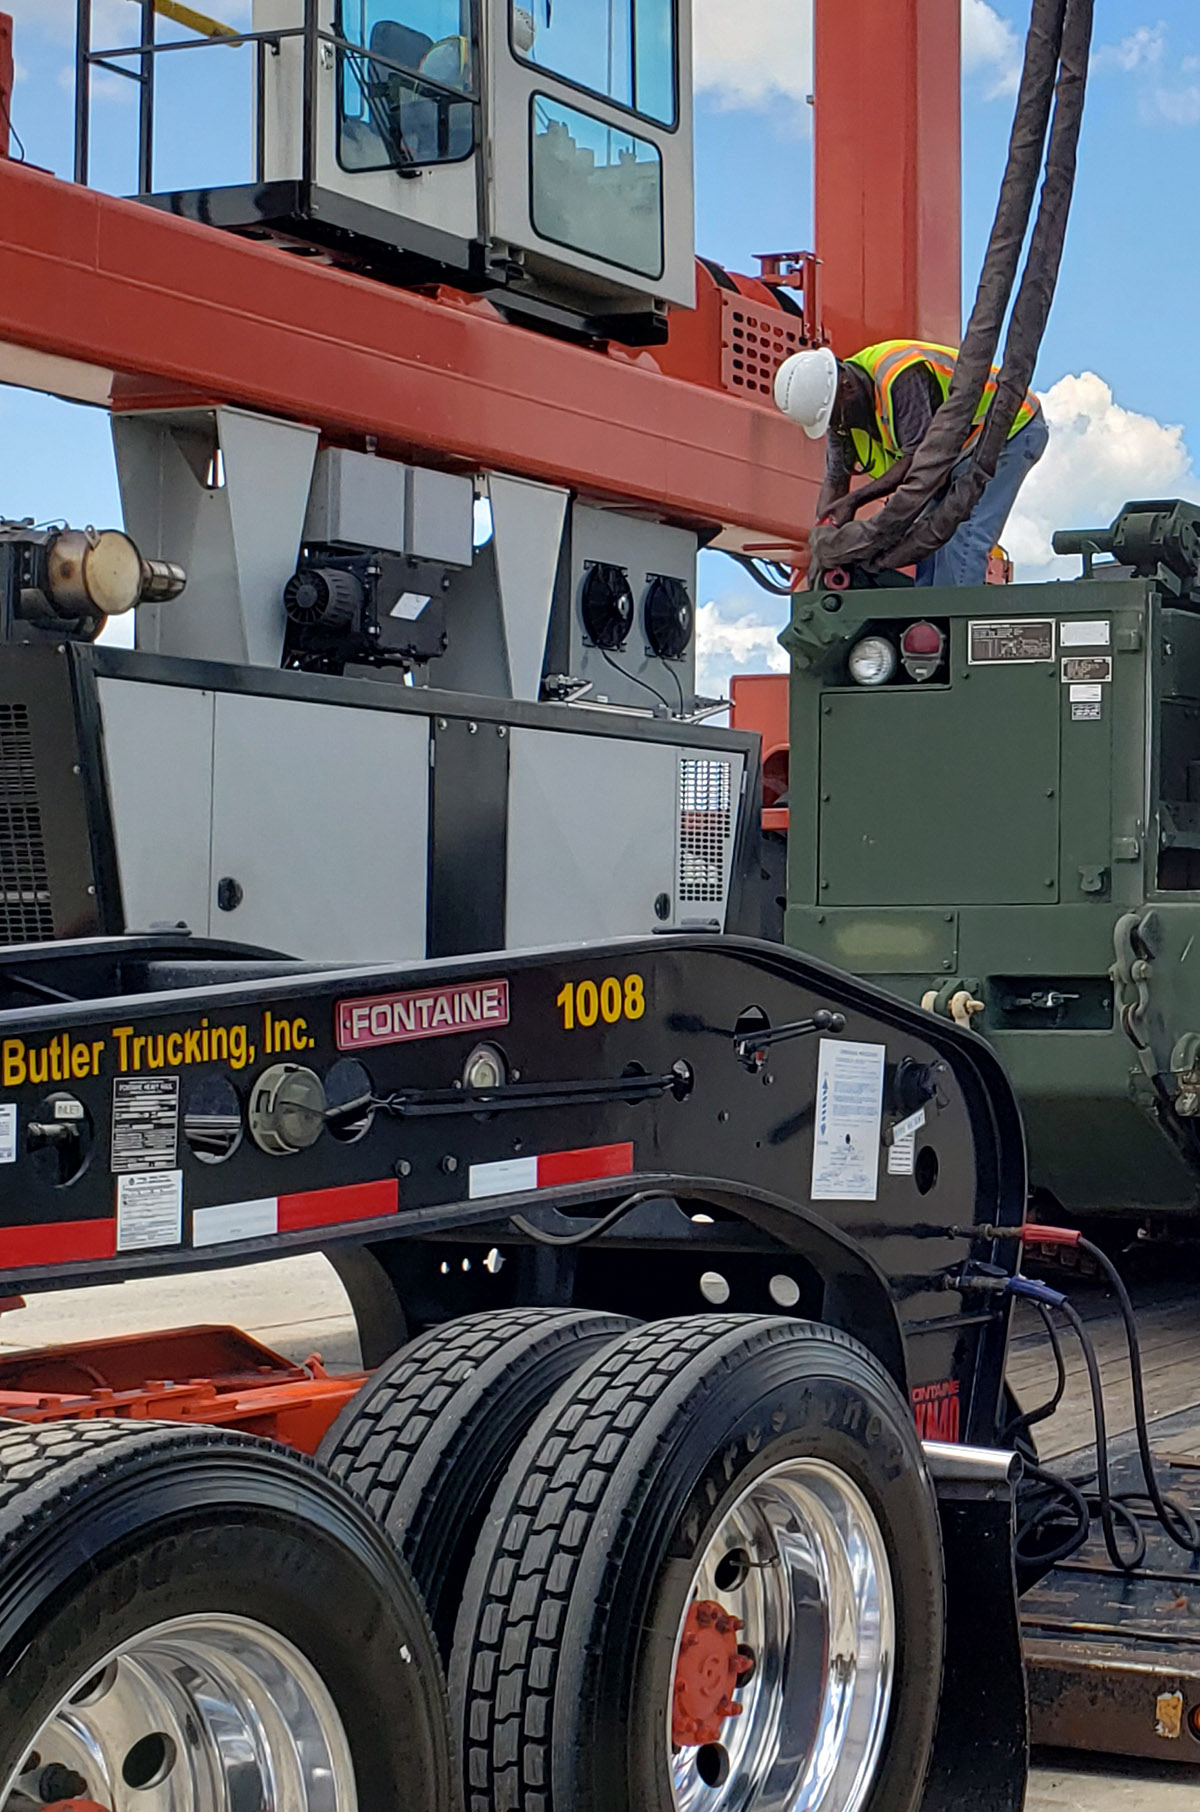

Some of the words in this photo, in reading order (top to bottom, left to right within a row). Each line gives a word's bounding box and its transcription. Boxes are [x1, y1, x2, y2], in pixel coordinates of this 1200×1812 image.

[351, 988, 500, 1039] FONTAINE
[556, 974, 646, 1030] 1008
[2, 1033, 104, 1087] Butler
[112, 1018, 255, 1070] Trucking,
[264, 1011, 315, 1054] Inc.
[911, 1380, 960, 1403] ONTAINE
